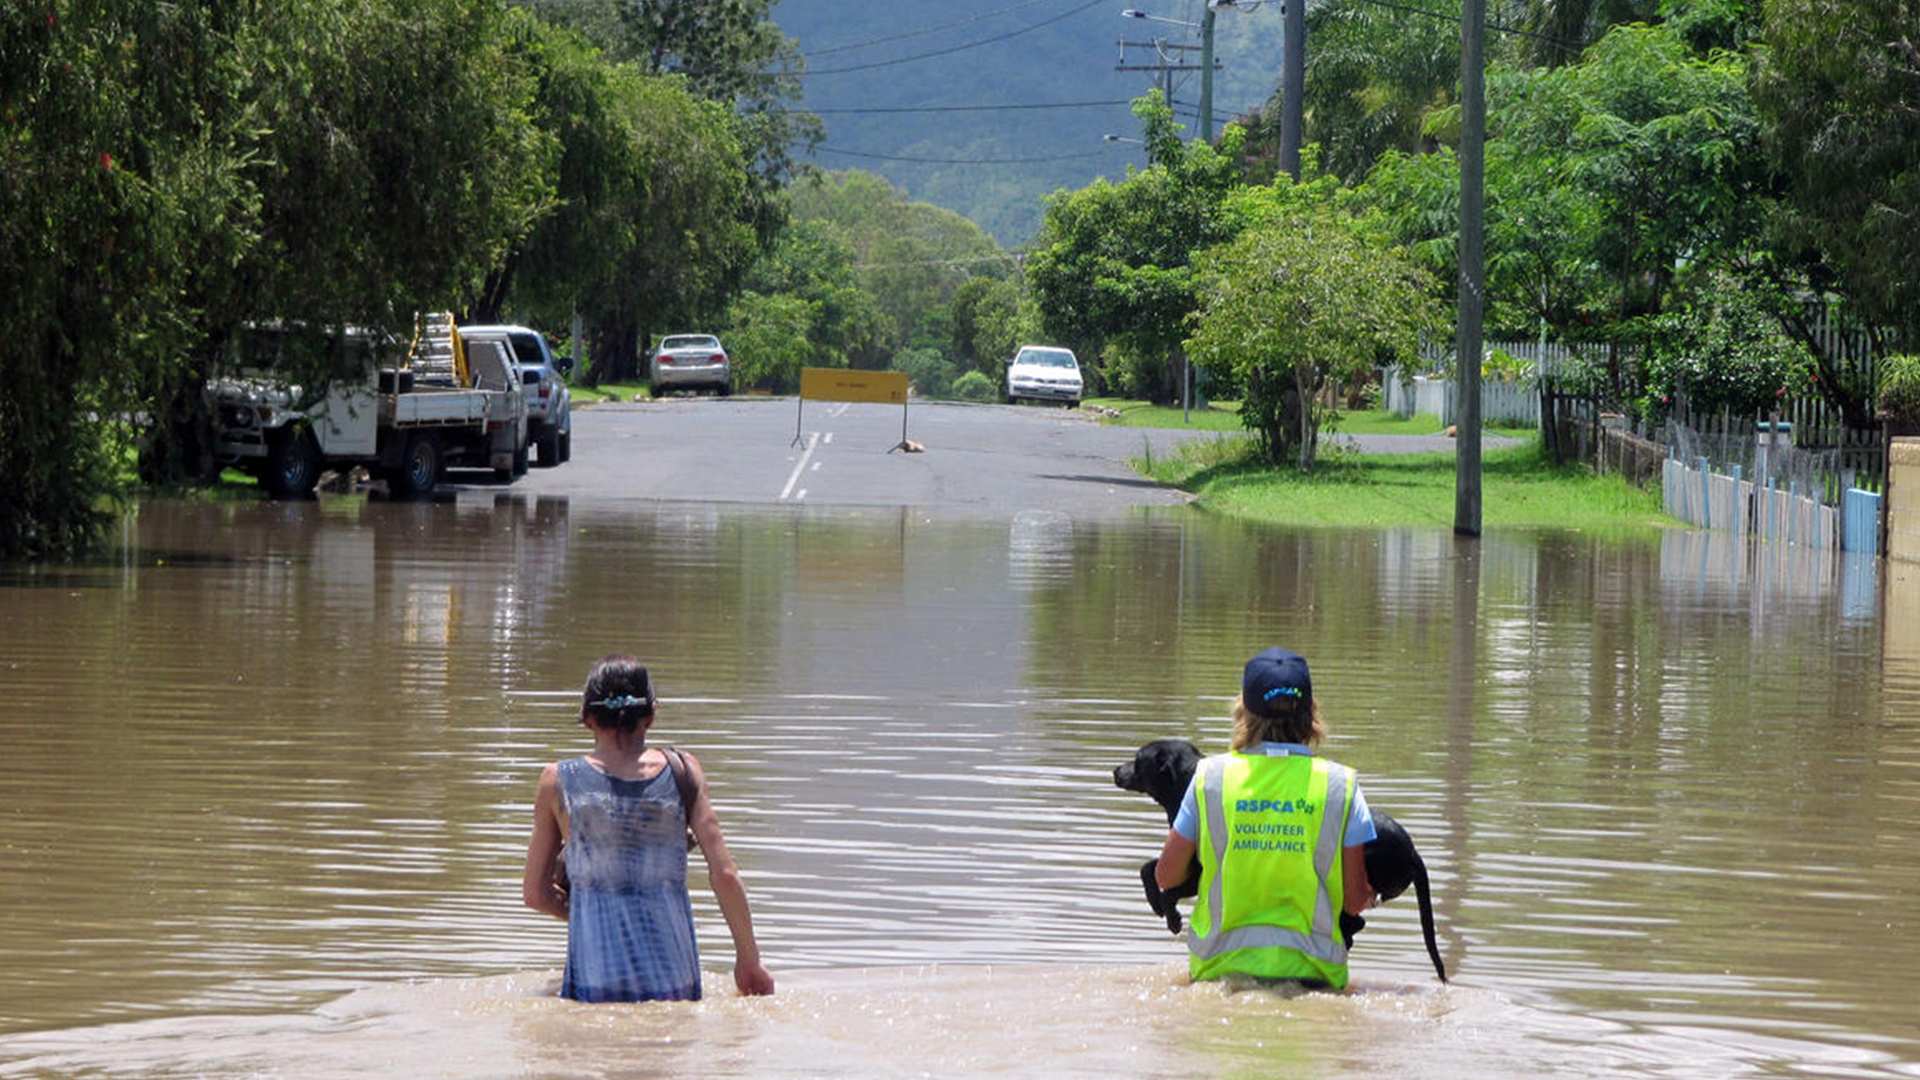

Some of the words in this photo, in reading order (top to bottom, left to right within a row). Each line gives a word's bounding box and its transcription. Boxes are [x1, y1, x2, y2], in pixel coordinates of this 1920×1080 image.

[1236, 799, 1294, 813] RSPCA
[1234, 823, 1304, 836] VOLUNTEER
[1233, 839, 1306, 852] AMBULANCE
